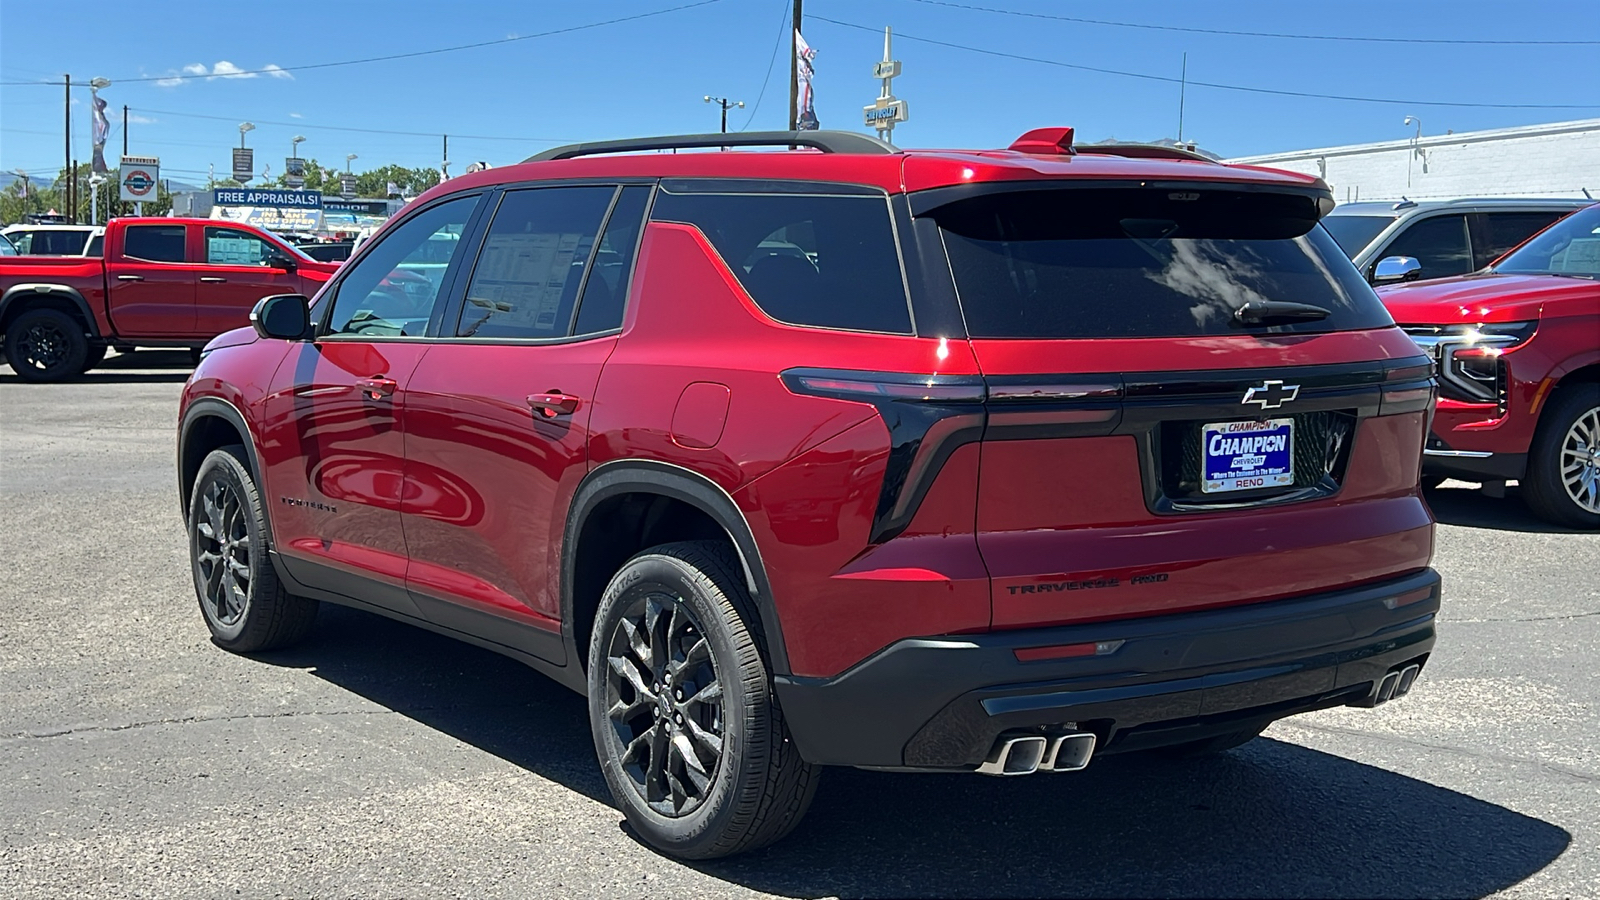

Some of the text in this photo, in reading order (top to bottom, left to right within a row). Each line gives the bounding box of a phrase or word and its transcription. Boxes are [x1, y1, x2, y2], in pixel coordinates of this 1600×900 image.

[217, 192, 318, 205] FREE APPRAISALS!
[323, 204, 370, 212] TAHOE
[249, 216, 316, 225] CASH OFFER
[1228, 420, 1272, 432] CHAMPION
[1209, 434, 1287, 457] CHAMPION
[1233, 457, 1264, 466] CHEVROLET
[1236, 478, 1264, 488] RENO
[1006, 576, 1121, 595] TRAVERSE
